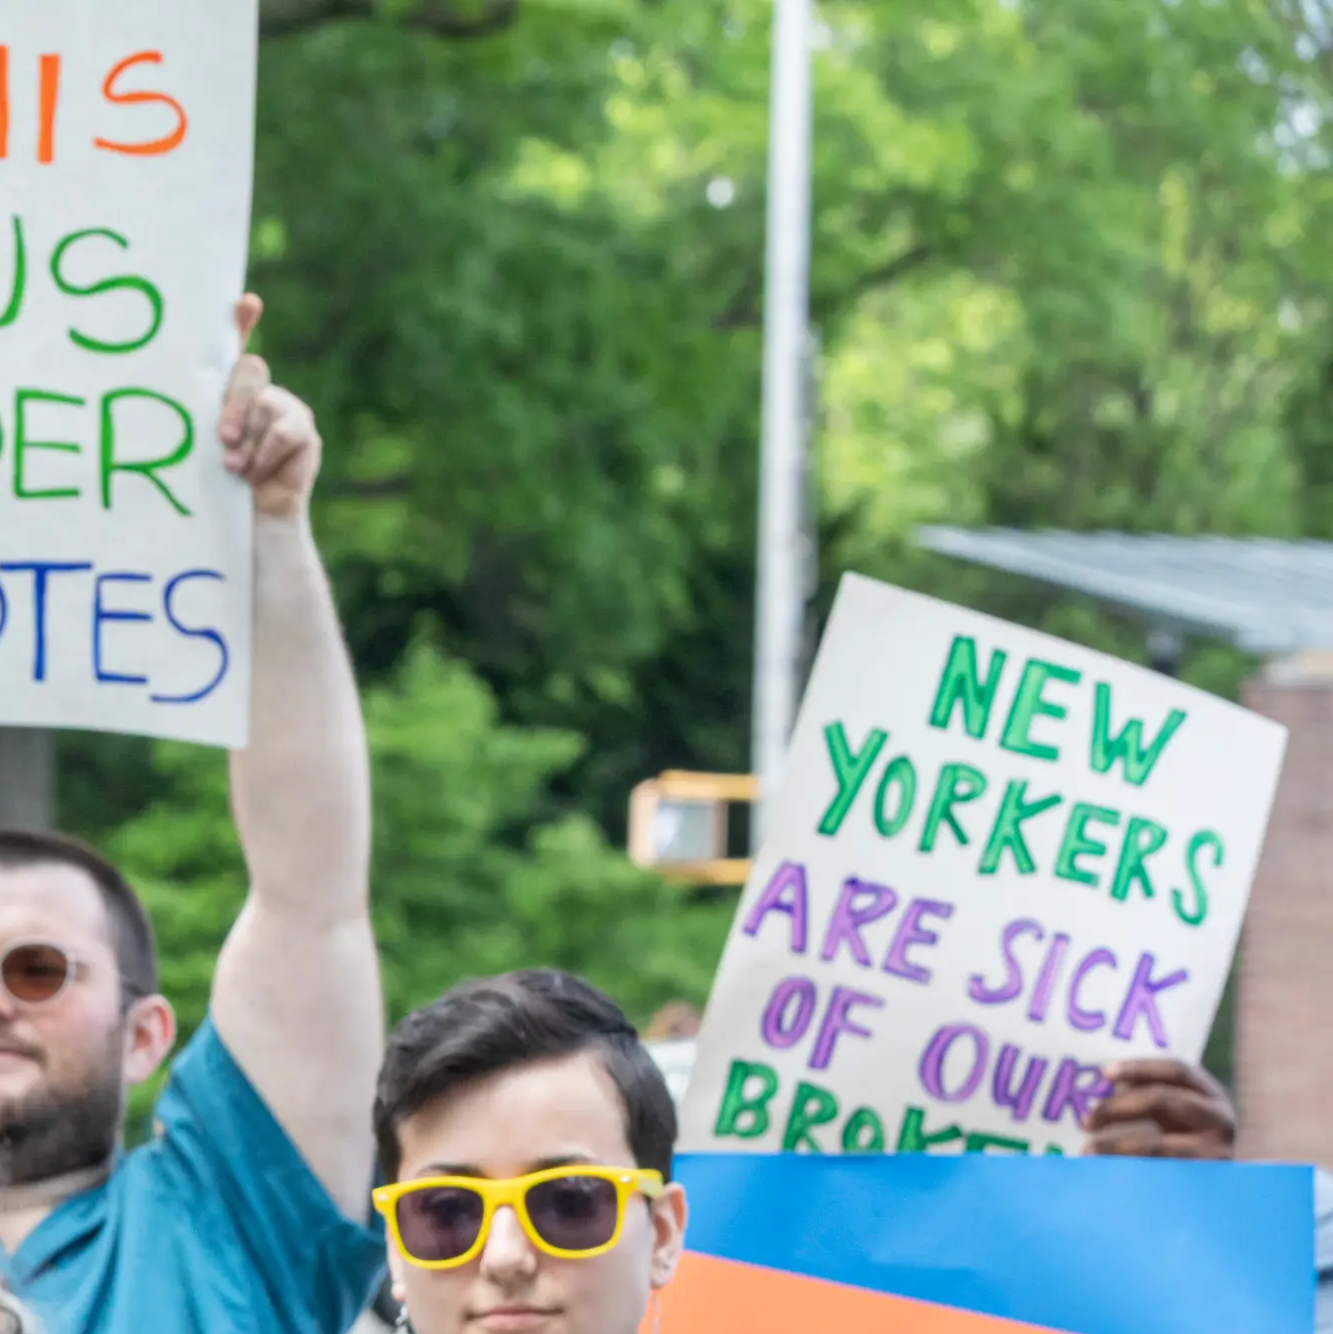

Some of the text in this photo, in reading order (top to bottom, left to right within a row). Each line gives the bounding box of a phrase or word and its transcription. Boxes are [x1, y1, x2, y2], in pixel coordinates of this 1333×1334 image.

[928, 635, 1188, 786] NEW
[817, 720, 1226, 927] YORKERS
[742, 860, 1189, 1048] ARE SICK
[713, 1057, 1066, 1156] BROK
[760, 975, 1117, 1127] OF OUR
